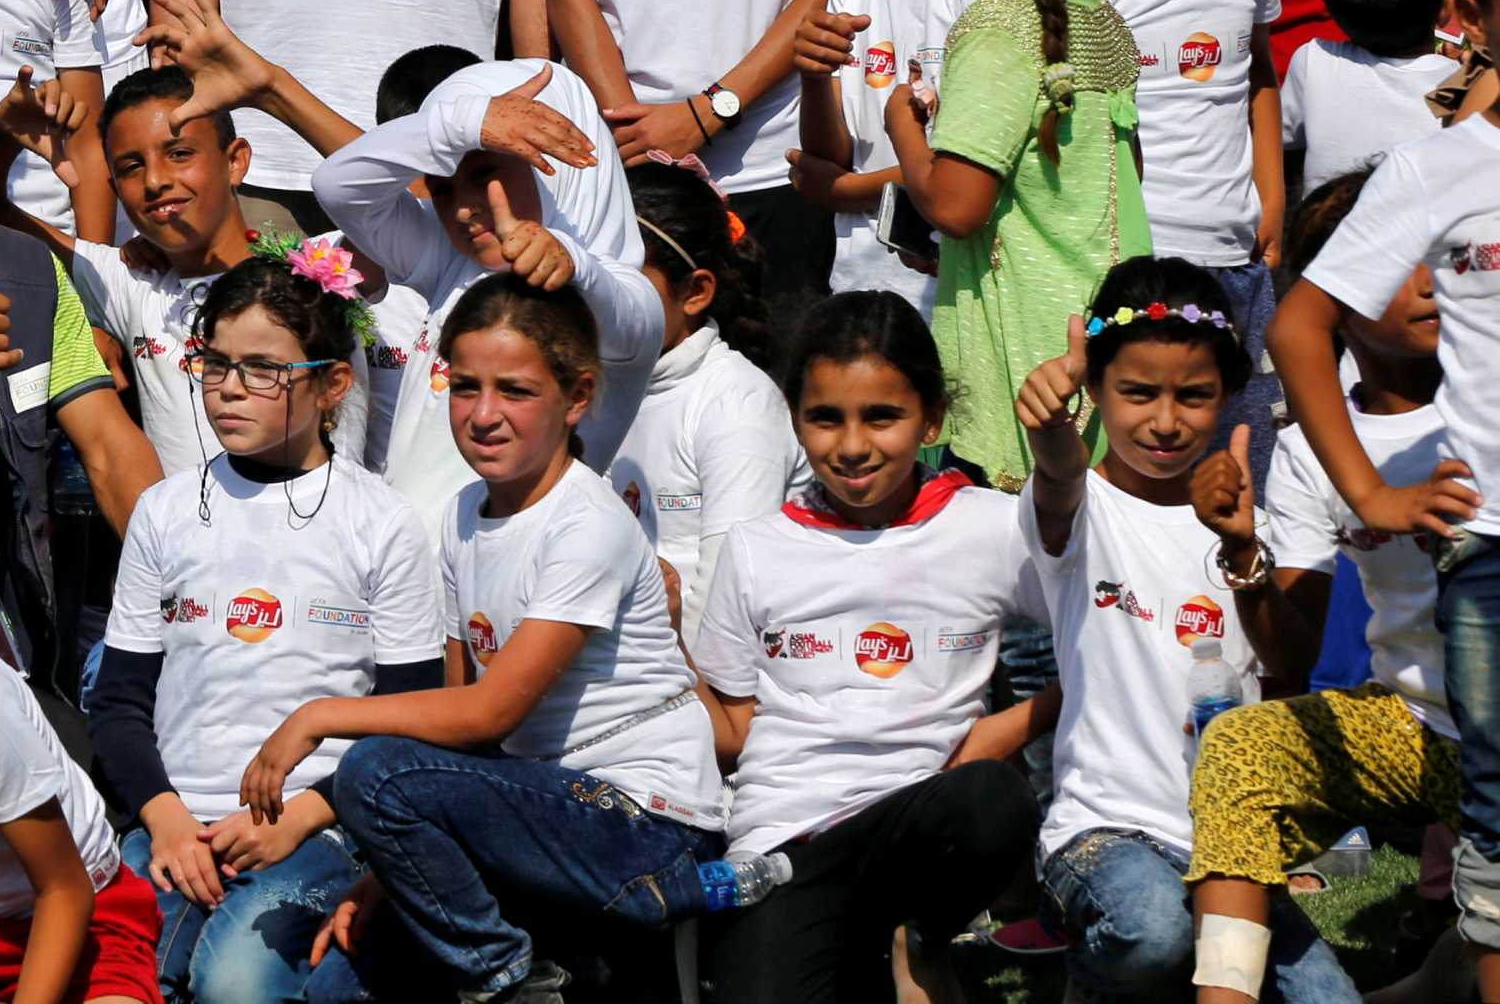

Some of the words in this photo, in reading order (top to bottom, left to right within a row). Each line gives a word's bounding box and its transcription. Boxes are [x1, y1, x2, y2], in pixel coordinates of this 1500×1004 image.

[1180, 46, 1204, 66] Lay's
[228, 602, 258, 623] Lay's
[308, 608, 369, 625] FOUNDATION
[1176, 607, 1208, 632] Lay's
[790, 633, 815, 642] ASIAN
[855, 636, 885, 660] Lay's
